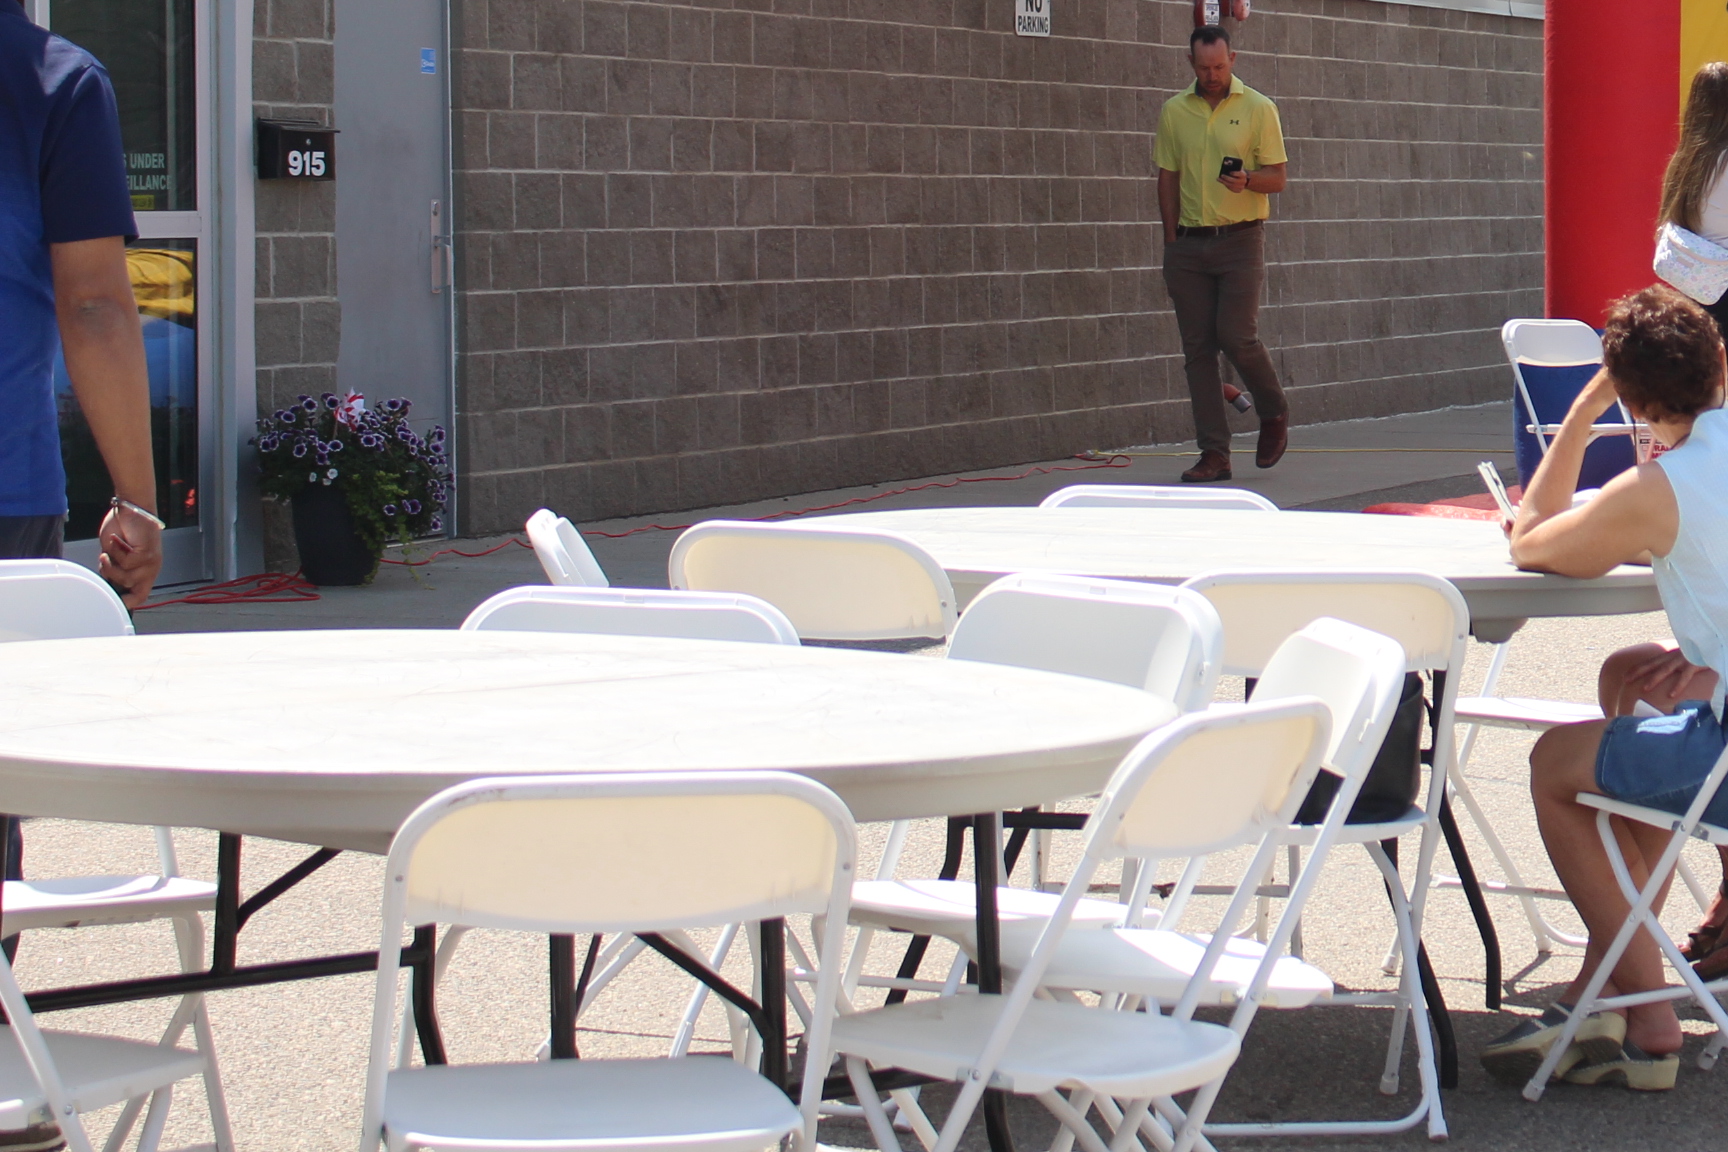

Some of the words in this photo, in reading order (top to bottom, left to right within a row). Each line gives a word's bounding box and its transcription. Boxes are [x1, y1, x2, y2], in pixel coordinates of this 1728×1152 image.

[1018, 15, 1049, 34] PARKING
[130, 152, 165, 169] UNDER
[288, 150, 326, 177] 915
